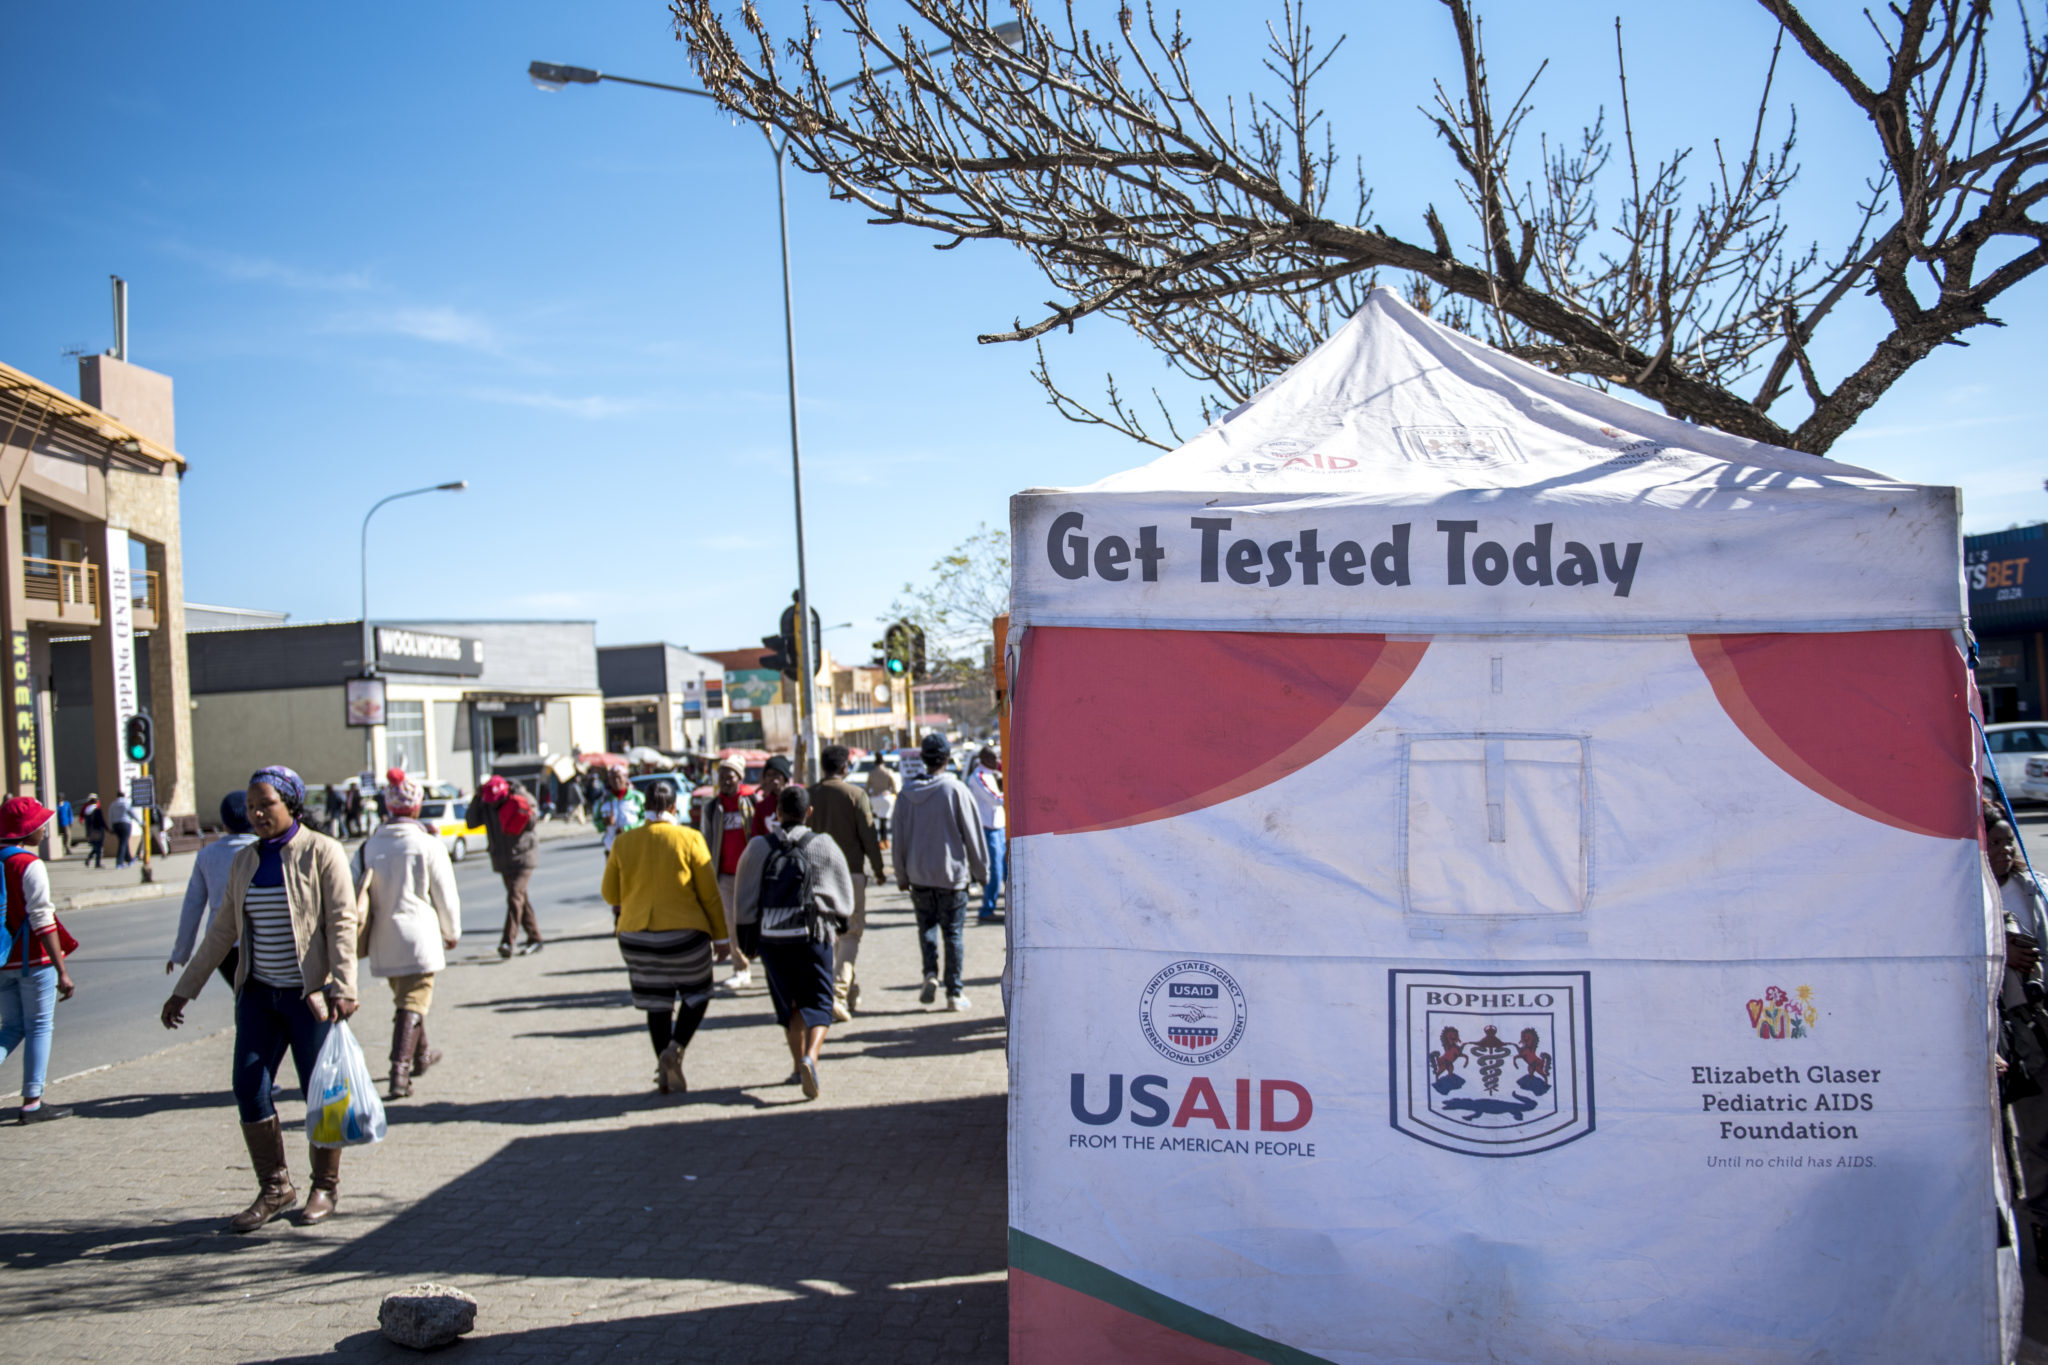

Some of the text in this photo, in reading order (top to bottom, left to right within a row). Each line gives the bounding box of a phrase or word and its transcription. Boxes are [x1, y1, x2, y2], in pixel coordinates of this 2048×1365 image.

[1047, 511, 1643, 598] Get Tested Today
[113, 567, 129, 638] CENTRE
[1146, 962, 1241, 998] UNITED STATES AGENCY
[1173, 985, 1214, 996] USAID
[1426, 991, 1555, 1008] BOPHELO
[1141, 1011, 1245, 1064] INTERNATIONAL DEVELOPMENT
[1691, 1065, 1881, 1084] Elizabeth Glaser
[1070, 1073, 1314, 1132] USAID
[1702, 1093, 1874, 1112] Pediatric AIDS
[1720, 1121, 1858, 1140] Foundation
[1069, 1134, 1316, 1157] FROM THE AMERICAN PEOPLE
[1706, 1155, 1877, 1168] Until no child has AIDS.
